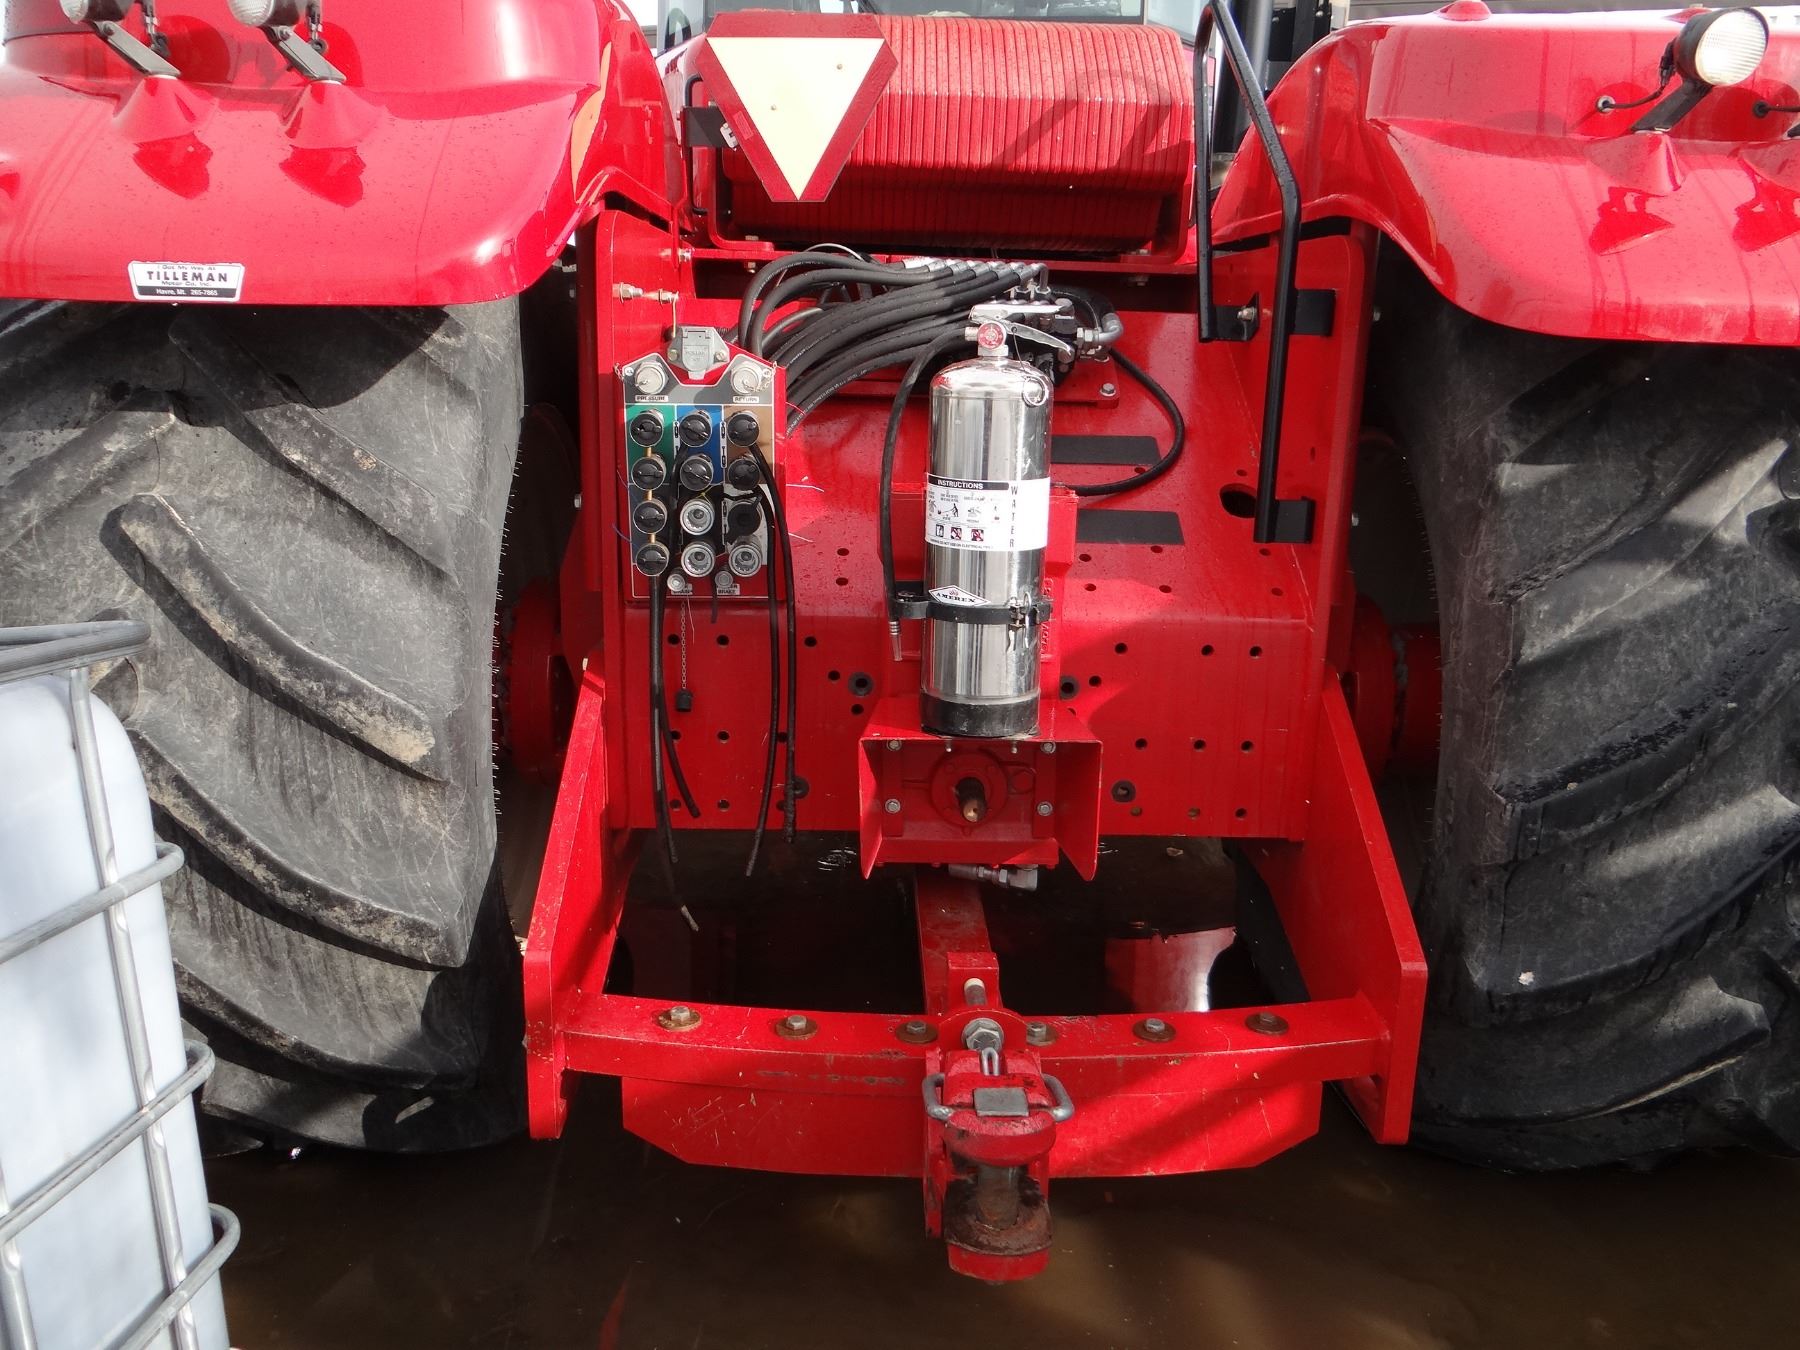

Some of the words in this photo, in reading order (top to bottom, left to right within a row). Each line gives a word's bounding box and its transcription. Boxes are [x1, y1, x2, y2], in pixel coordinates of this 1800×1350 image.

[147, 271, 228, 282] TILLEMAN
[937, 479, 984, 490] INSTRUCTIONS
[1009, 485, 1019, 548] WATER
[936, 592, 976, 603] AMEREX
